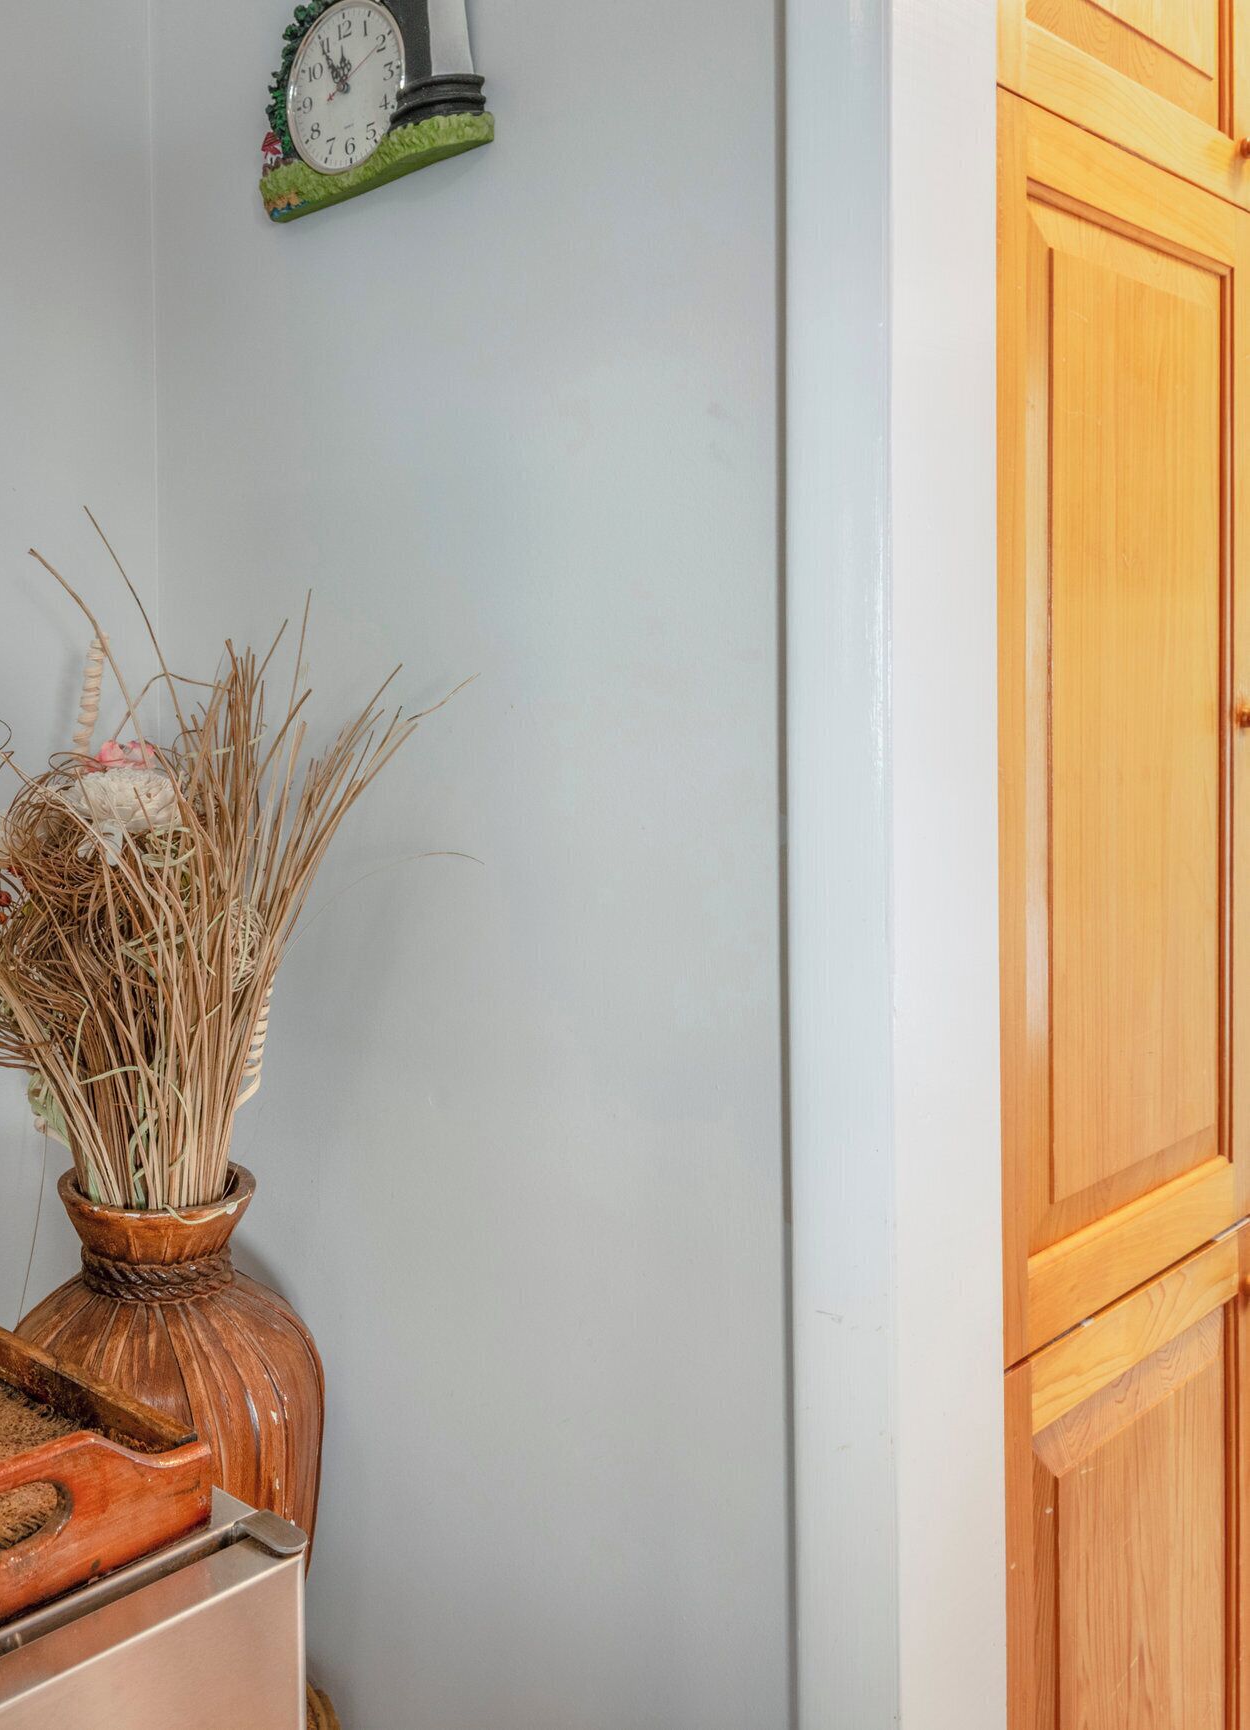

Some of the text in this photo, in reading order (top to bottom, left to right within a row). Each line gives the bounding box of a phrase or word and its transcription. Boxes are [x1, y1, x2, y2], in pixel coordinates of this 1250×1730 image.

[337, 20, 352, 41] 12
[362, 20, 369, 37] 1
[319, 37, 331, 55] 11
[375, 34, 387, 53] 2
[307, 62, 324, 82] 10
[383, 62, 395, 81] 3
[302, 97, 313, 114] 9
[379, 94, 389, 110] 4
[310, 123, 321, 140] 8
[365, 122, 377, 141] 5
[326, 138, 336, 155] 7
[345, 137, 356, 155] 6
